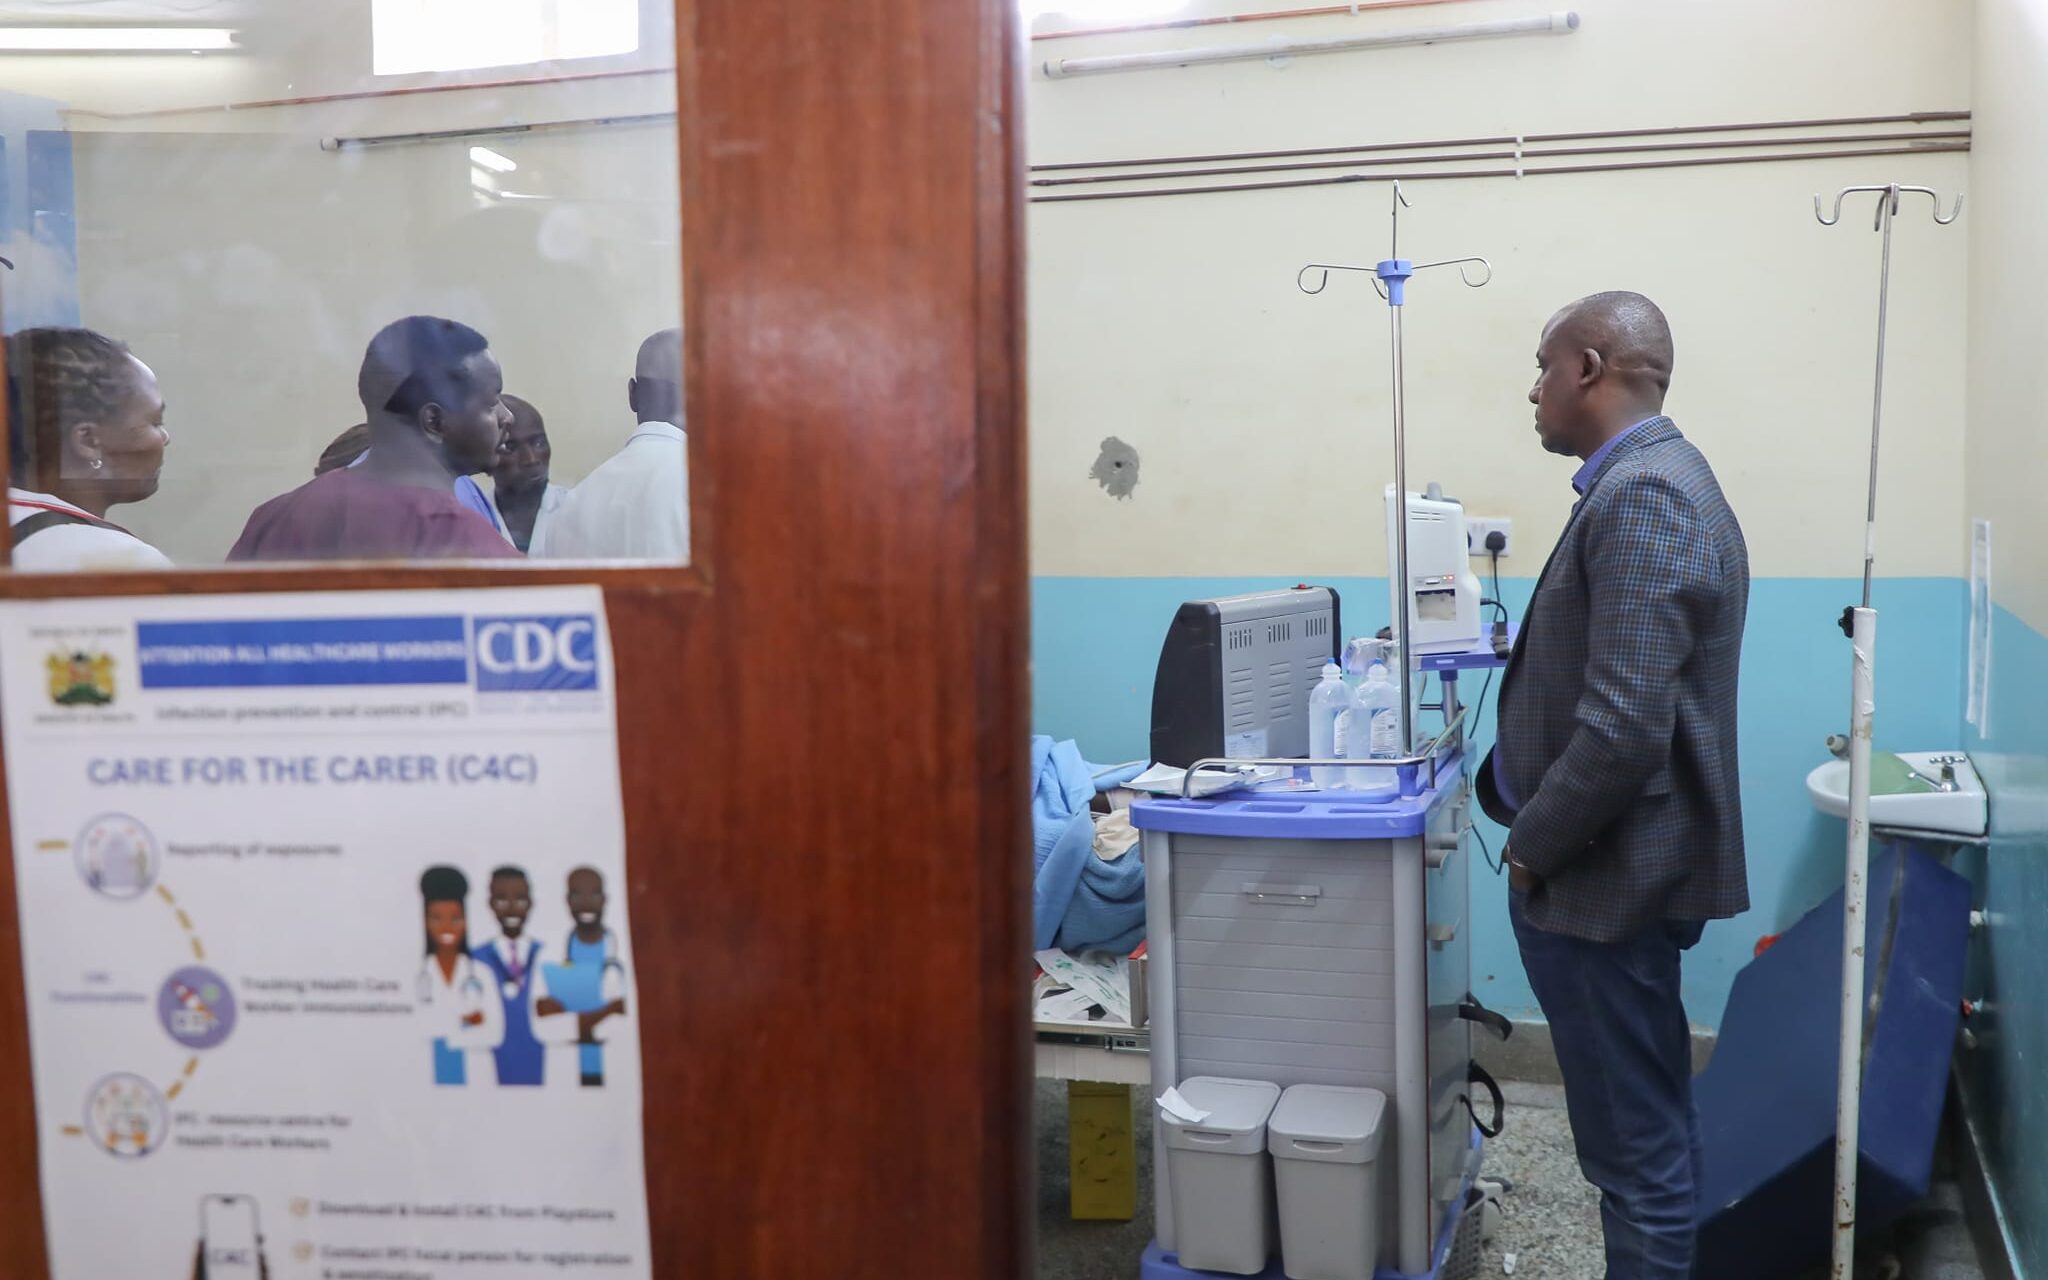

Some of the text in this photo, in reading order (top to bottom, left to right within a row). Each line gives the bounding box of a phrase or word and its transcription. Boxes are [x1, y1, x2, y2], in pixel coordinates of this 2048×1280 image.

[477, 620, 595, 673] CDC
[87, 754, 538, 786] CARE FOR THE CARER (C4C)
